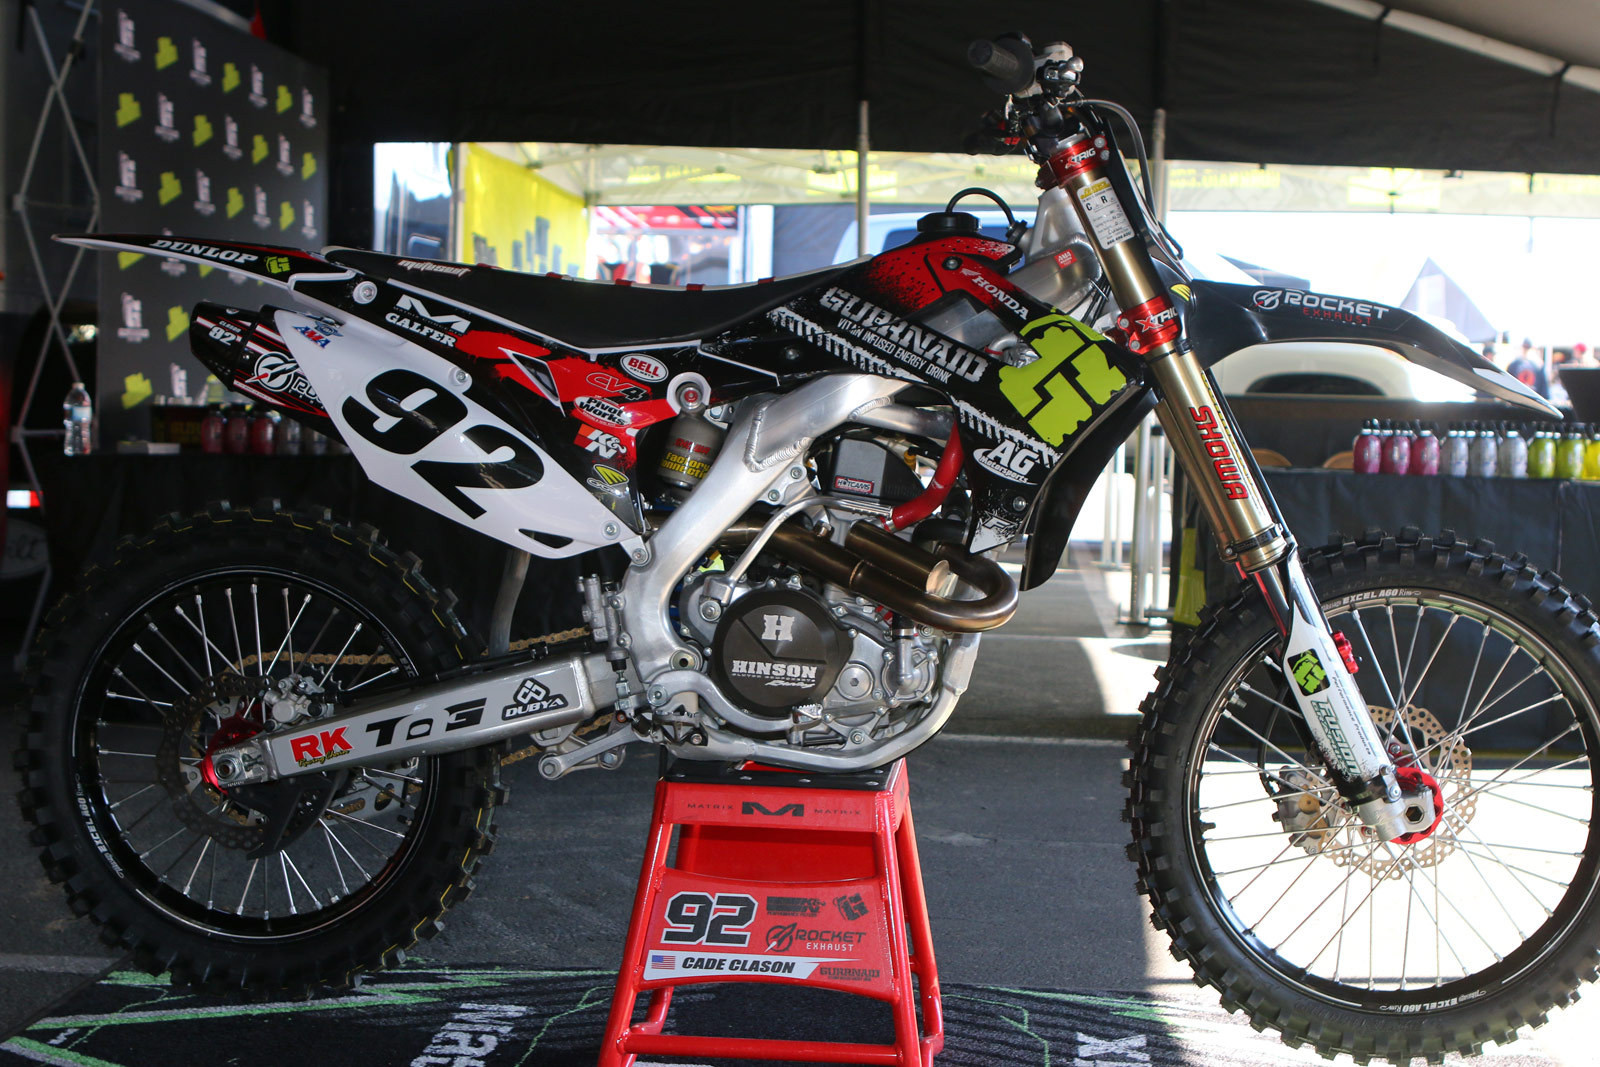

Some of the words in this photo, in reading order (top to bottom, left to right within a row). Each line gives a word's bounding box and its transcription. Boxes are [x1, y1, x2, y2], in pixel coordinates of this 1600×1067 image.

[1065, 148, 1096, 169] XTRIG
[149, 239, 258, 263] DUNLOP
[971, 276, 1029, 320] HONDA
[1283, 289, 1389, 319] ROCKET
[1303, 307, 1373, 325] EXHAUST
[208, 326, 237, 346] 92
[293, 326, 331, 348] AMA
[385, 312, 457, 348] GALFER
[628, 358, 661, 377] BELL
[861, 330, 896, 355] INFUSED
[894, 346, 927, 370] ENERGY
[925, 363, 952, 384] DRINK
[586, 372, 648, 401] CV4
[579, 401, 627, 426] Works
[586, 397, 625, 417] Pivot
[341, 369, 545, 520] 92
[1188, 405, 1249, 500] SHOWA
[992, 438, 1040, 476] AG
[984, 456, 1034, 484] Motorsports
[1342, 591, 1377, 605] EXCEL
[1378, 588, 1398, 597] A60
[761, 614, 795, 641] H
[731, 660, 817, 679] HINSON
[505, 697, 565, 718] DUBYA
[289, 725, 354, 762] RK
[1318, 697, 1362, 774] FUSION
[85, 818, 109, 853] EXCEL
[660, 891, 759, 948] 92
[795, 929, 866, 943] ROCKET
[806, 942, 854, 952] EXHAUST
[682, 957, 727, 970] CADE
[728, 959, 796, 973] CLASON
[1402, 1003, 1421, 1012] A60
[1423, 997, 1458, 1011] EXCEL
